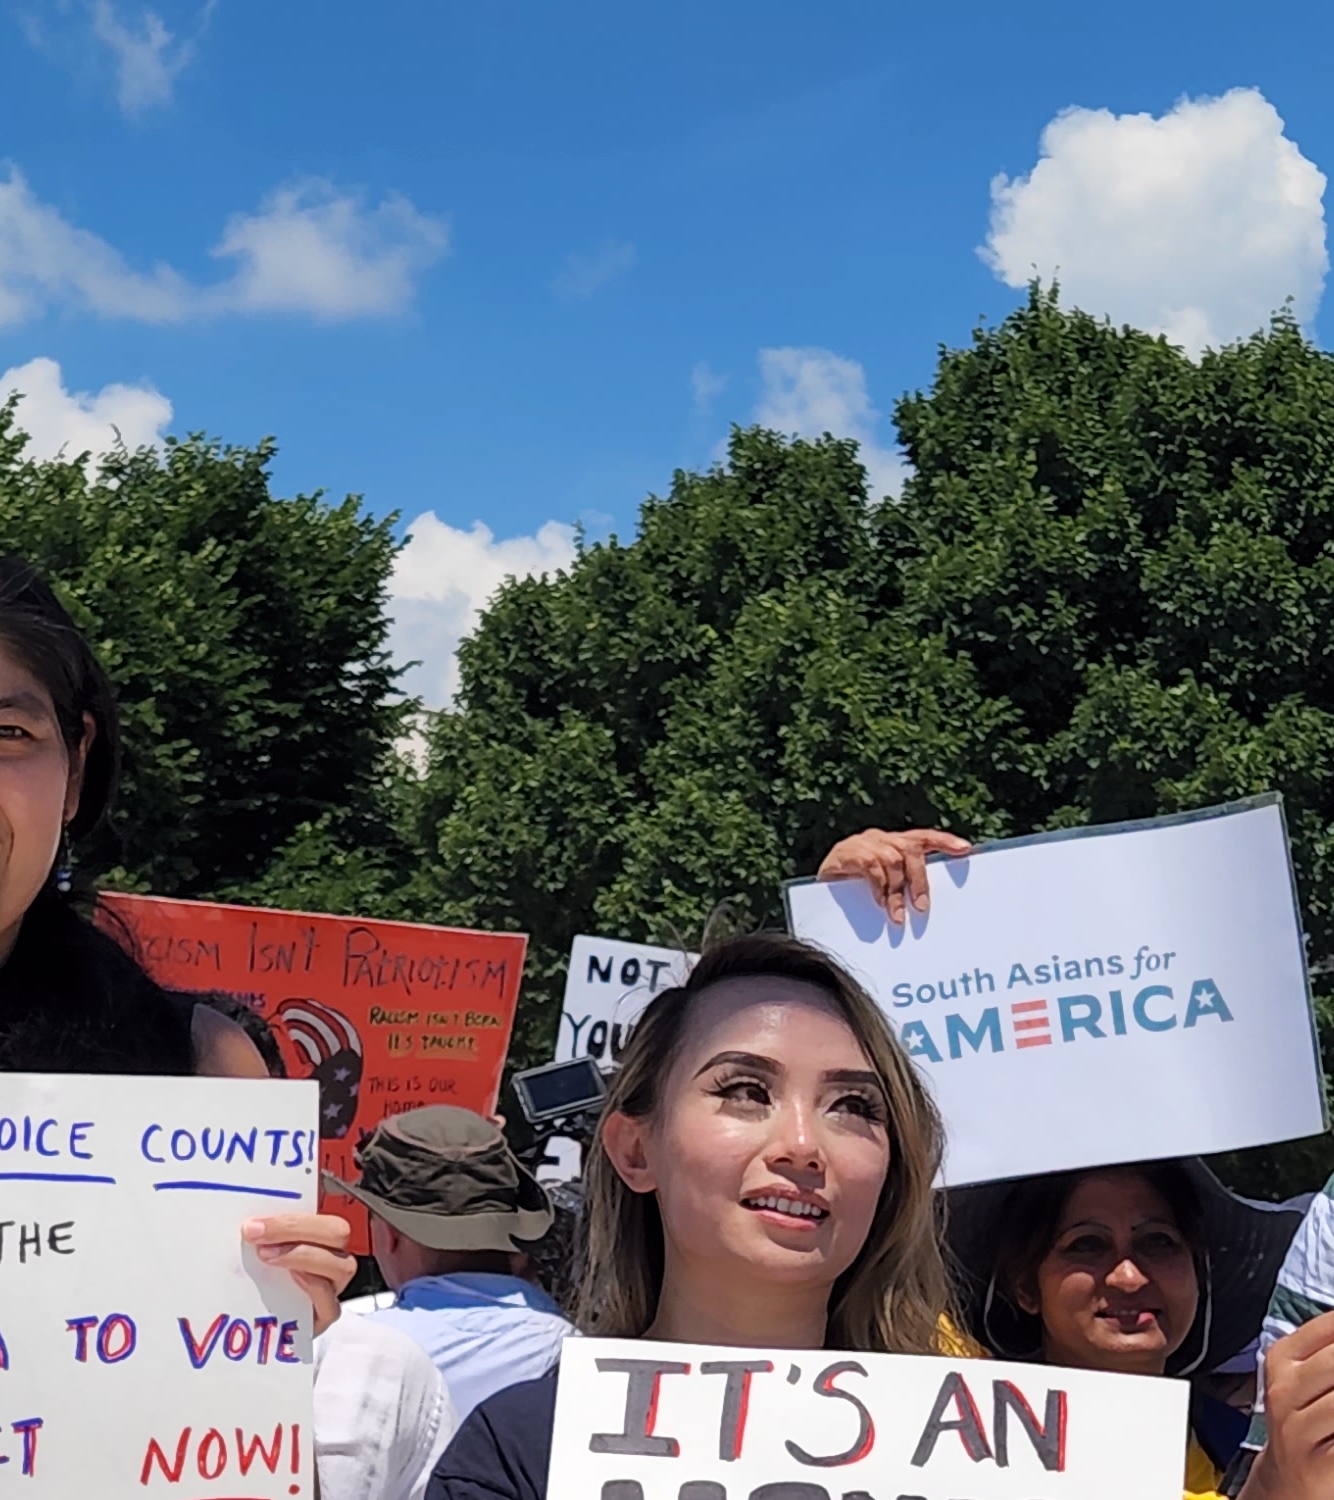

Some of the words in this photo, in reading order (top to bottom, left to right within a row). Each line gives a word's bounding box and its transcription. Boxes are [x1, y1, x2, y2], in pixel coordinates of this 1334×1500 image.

[587, 955, 671, 992] NOT
[892, 968, 995, 1007] South
[1007, 954, 1124, 990] Asians
[1129, 945, 1176, 980] for
[900, 978, 1234, 1063] AMERICA
[406, 1079, 422, 1092] IS
[429, 1077, 458, 1095] OUR
[141, 1125, 316, 1174] COUNTS!
[65, 1313, 137, 1363] TO
[178, 1313, 301, 1368] VOTE
[589, 1358, 875, 1467] IT'S
[911, 1372, 1067, 1471] AN
[140, 1423, 301, 1495] NOW!
